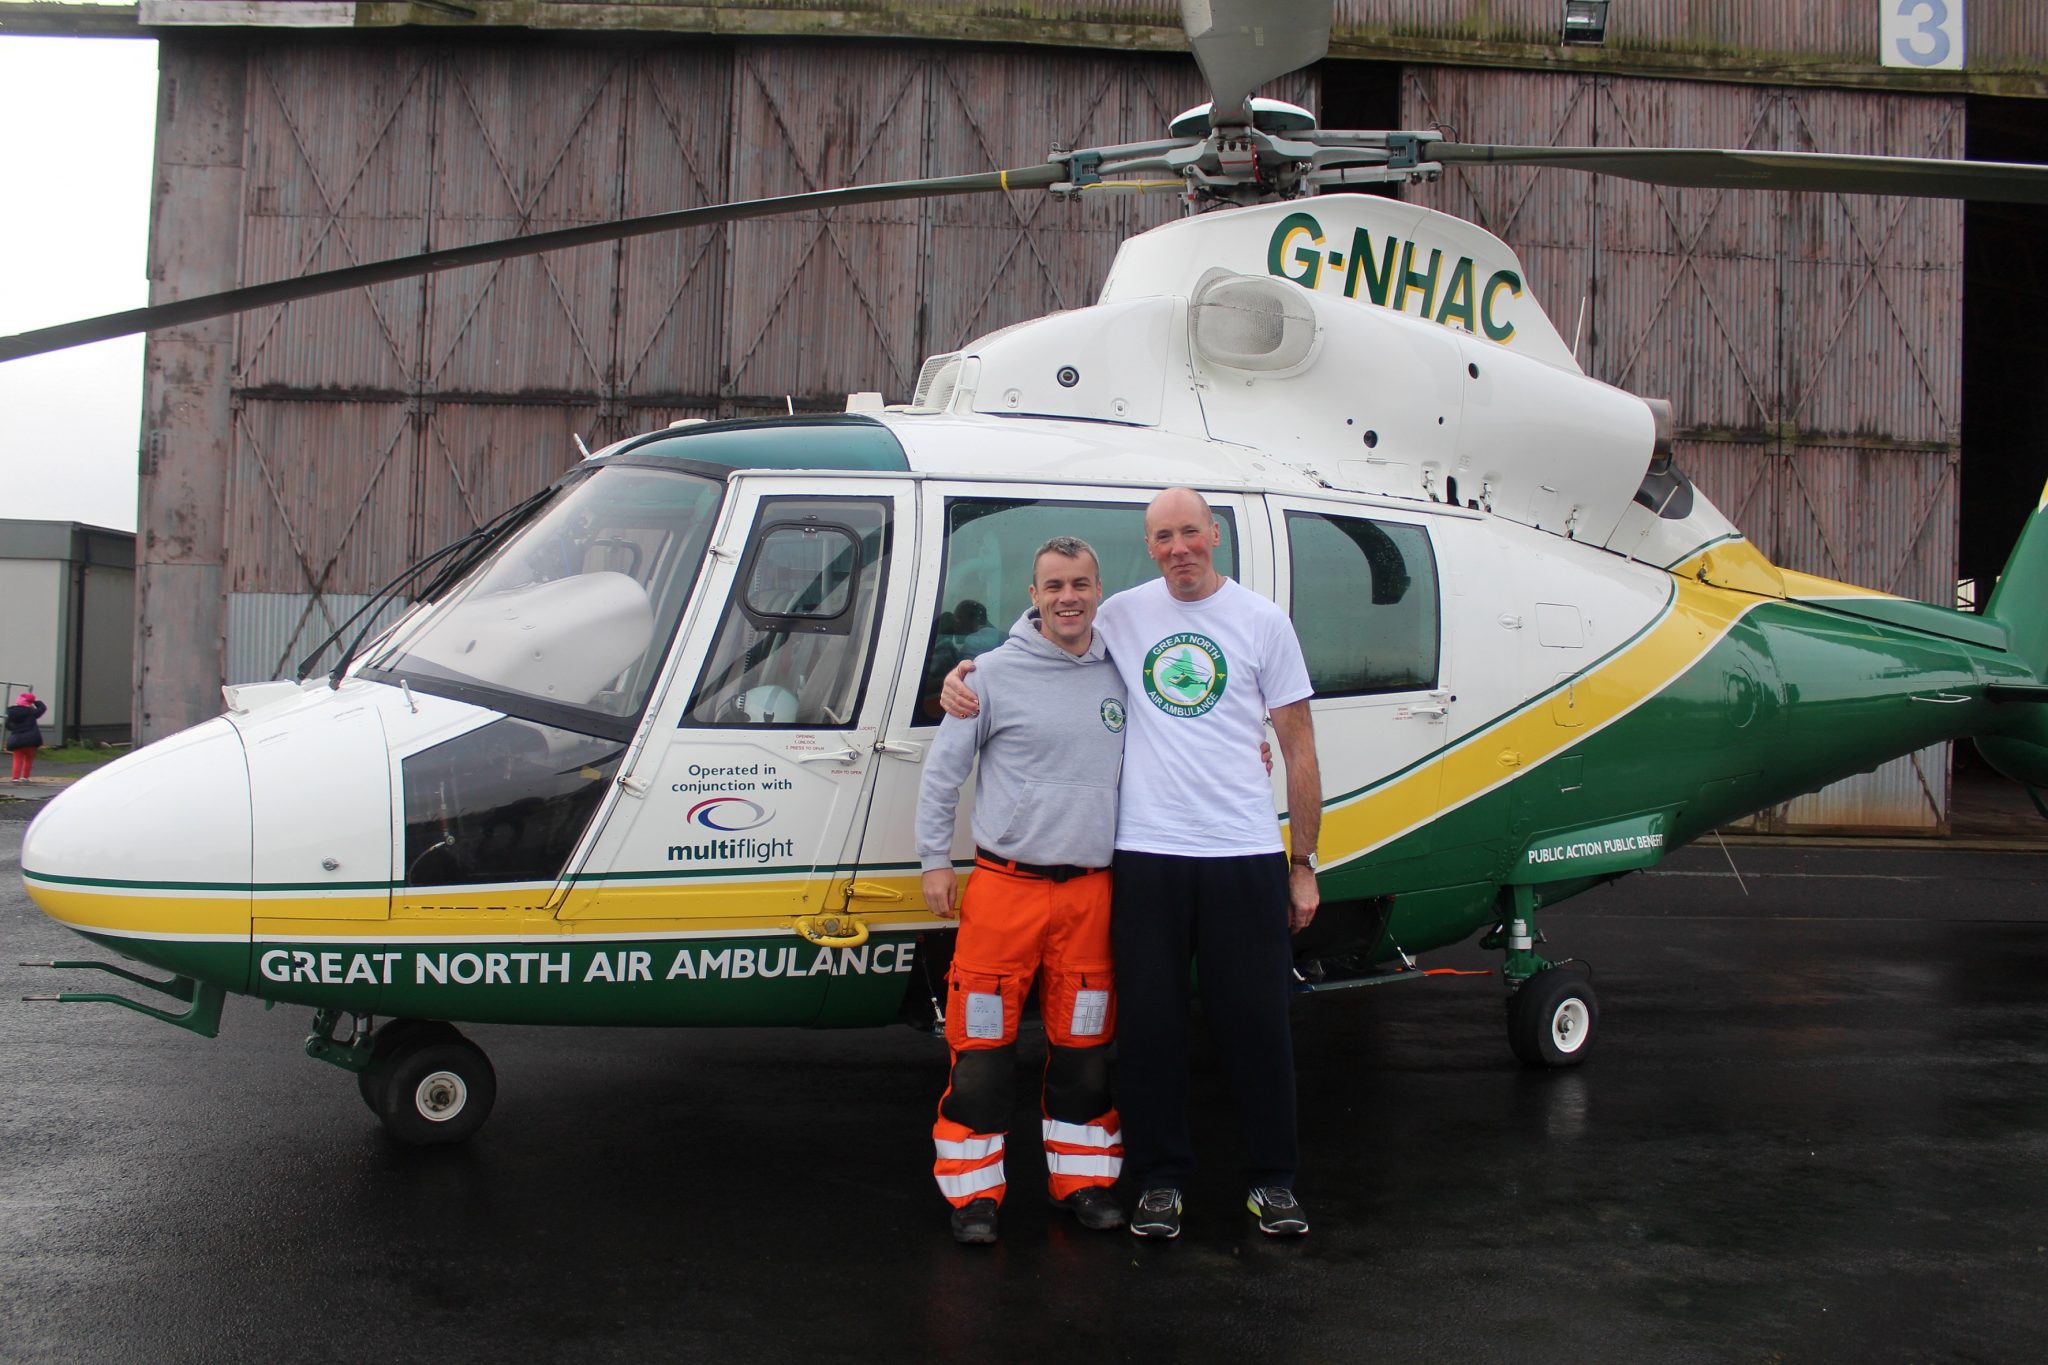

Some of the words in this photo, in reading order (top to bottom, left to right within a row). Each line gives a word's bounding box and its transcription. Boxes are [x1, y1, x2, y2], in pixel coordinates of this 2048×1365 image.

[1895, 0, 1951, 67] 3
[1267, 212, 1523, 345] G-NHAC
[1152, 634, 1188, 655] GREAT
[1189, 635, 1221, 660] NORTH
[1148, 691, 1163, 706] AIR
[1162, 691, 1219, 716] AMBULANCE
[688, 764, 758, 779] Operated
[764, 763, 777, 775] in
[671, 779, 756, 794] conjunction
[761, 778, 793, 790] with
[668, 838, 794, 863] multiflight
[1528, 846, 1565, 864] PUBLIC
[1566, 841, 1603, 859] ACTION
[1604, 836, 1637, 853] PUBLIC
[1636, 834, 1664, 849] BENEFIT
[260, 950, 402, 984] GREAT
[416, 952, 570, 985] NORTH
[583, 951, 653, 982] AIR
[665, 943, 916, 980] AMBULANCE
